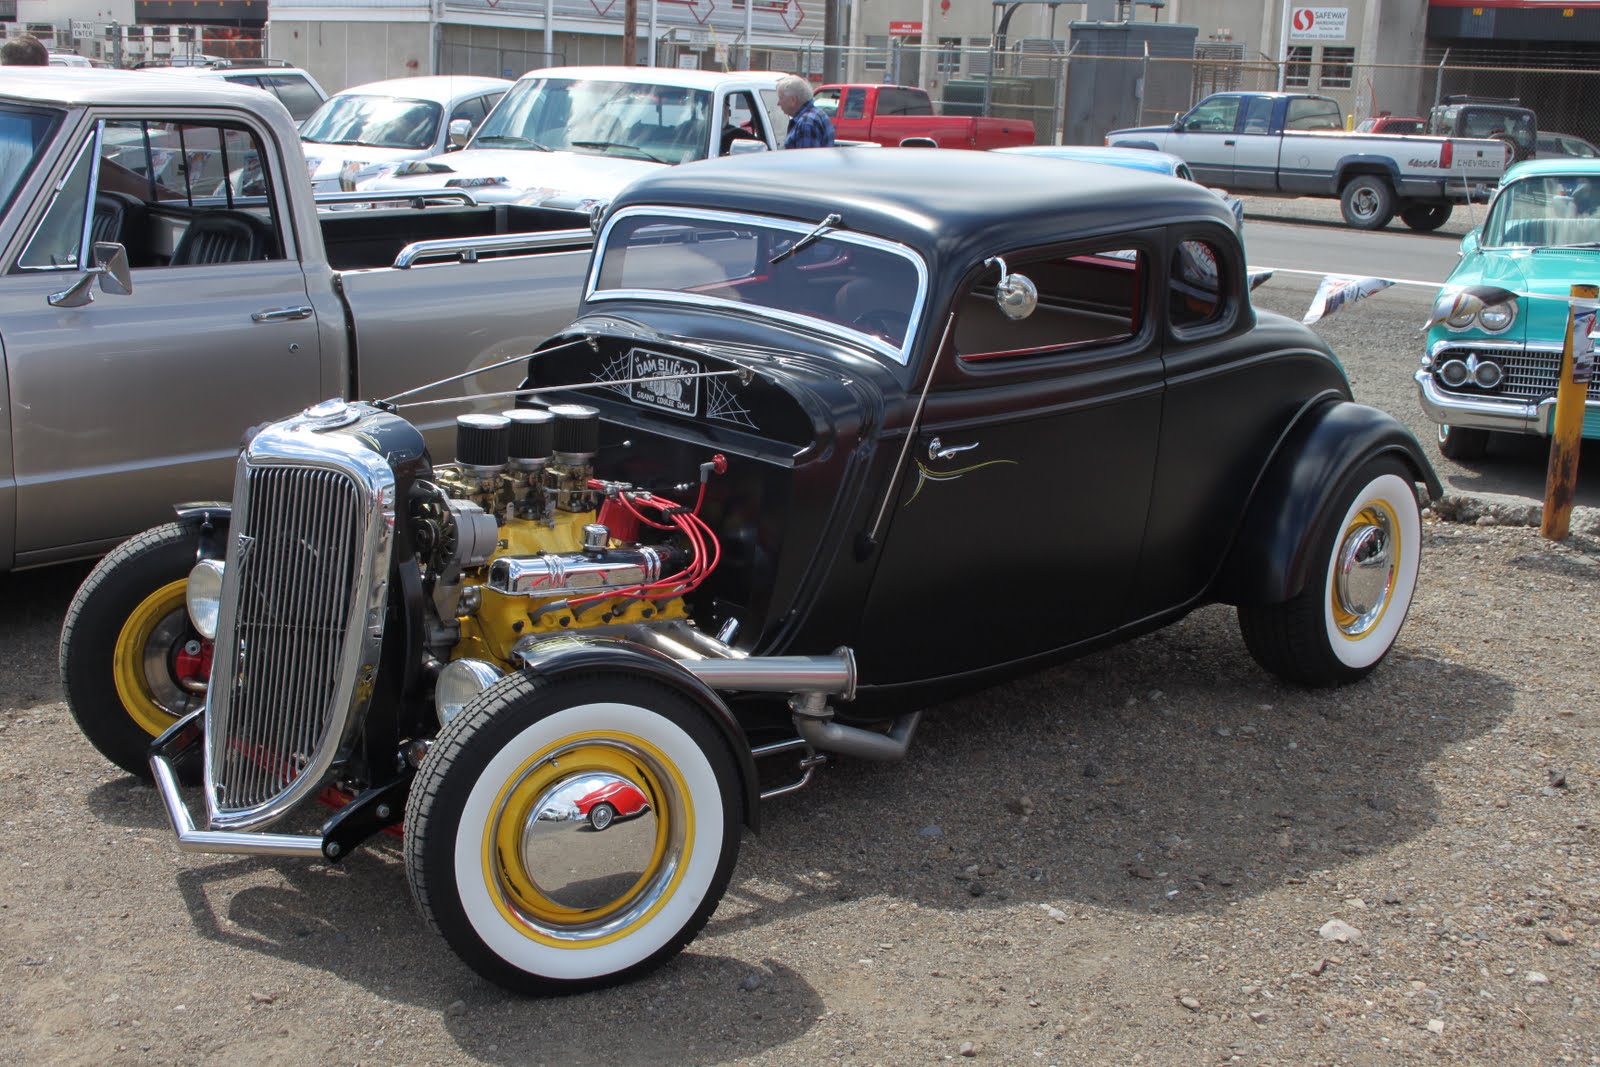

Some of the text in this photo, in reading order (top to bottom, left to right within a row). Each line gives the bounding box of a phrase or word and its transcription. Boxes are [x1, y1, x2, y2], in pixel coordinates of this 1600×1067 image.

[1315, 11, 1346, 19] SAFEWAY
[1457, 159, 1501, 169] CHEVROLET
[636, 391, 690, 411] GRAND COULEE DAM
